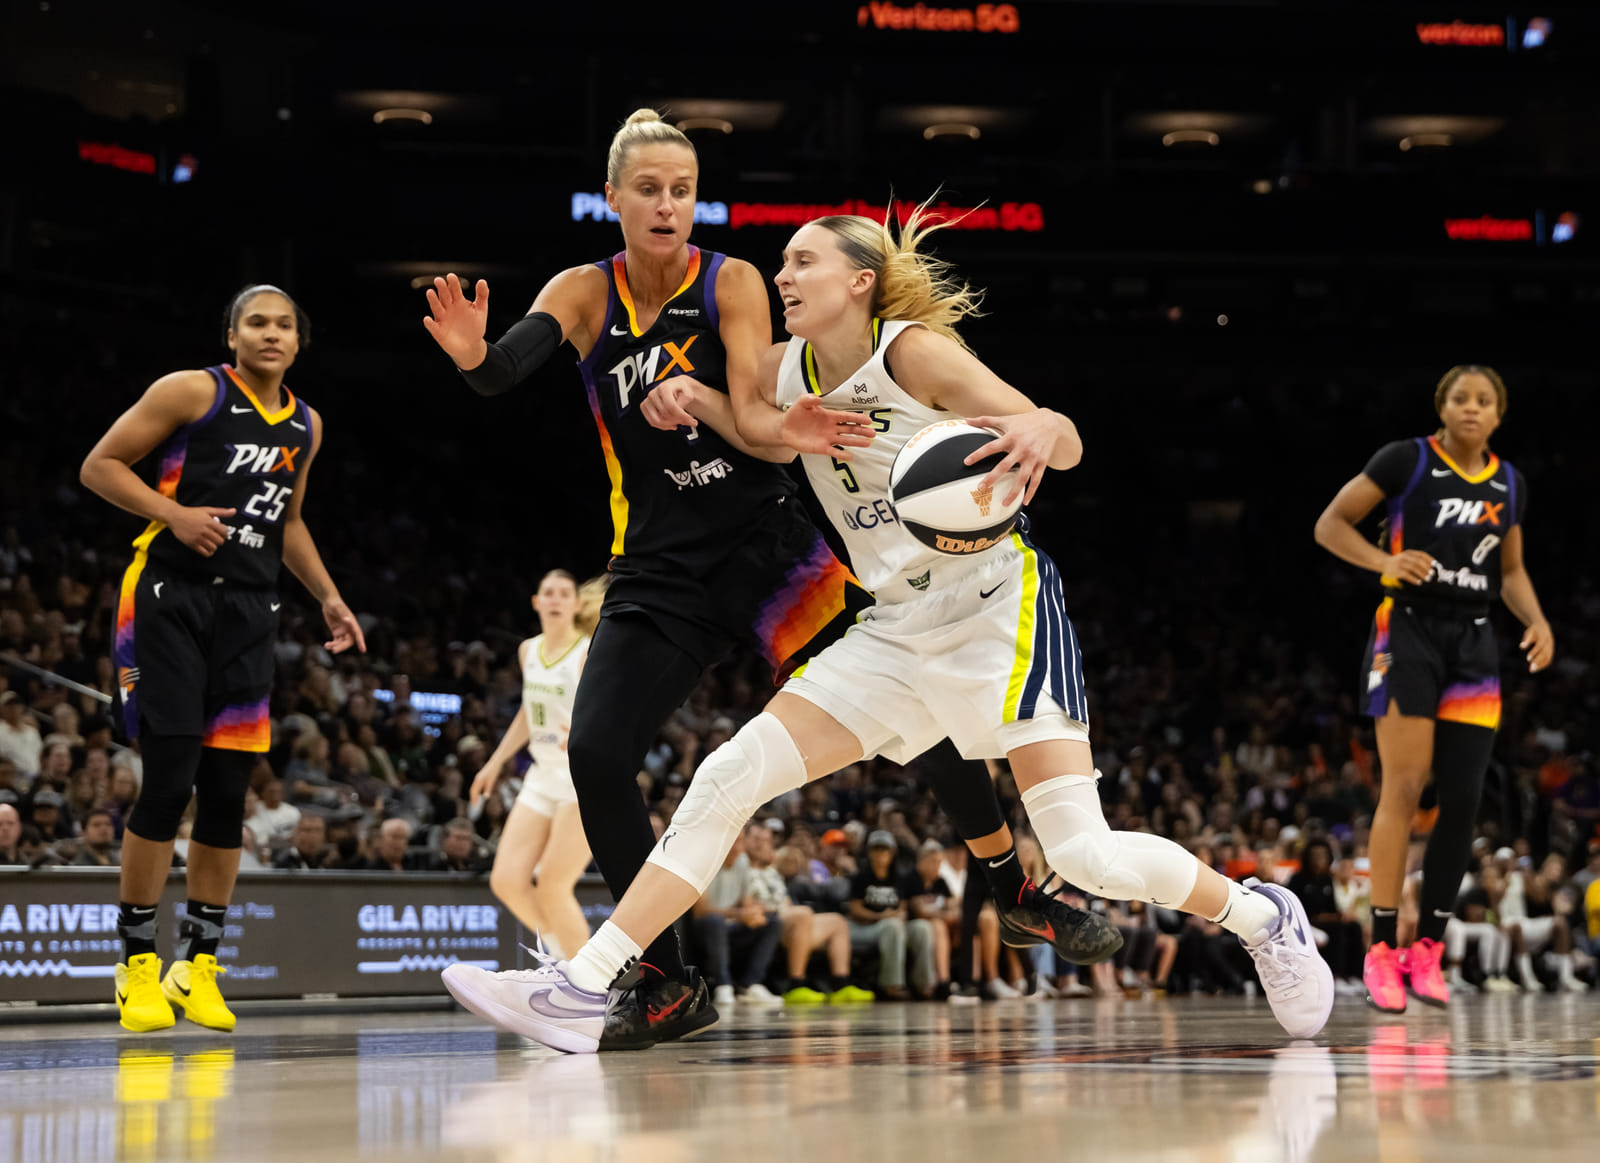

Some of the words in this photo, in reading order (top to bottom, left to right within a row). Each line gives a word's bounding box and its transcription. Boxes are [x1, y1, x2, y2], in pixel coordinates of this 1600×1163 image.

[869, 1, 974, 31] Verizon
[976, 3, 1019, 33] 5G
[1416, 20, 1504, 46] verizon
[1000, 202, 1044, 232] 5G
[1444, 214, 1532, 241] verizon
[608, 335, 699, 409] PHX
[226, 443, 300, 474] PHX
[244, 481, 293, 522] 25
[1435, 498, 1504, 528] PHX
[27, 904, 121, 933] RIVER
[358, 905, 420, 932] GILA
[422, 905, 498, 932] RIVER
